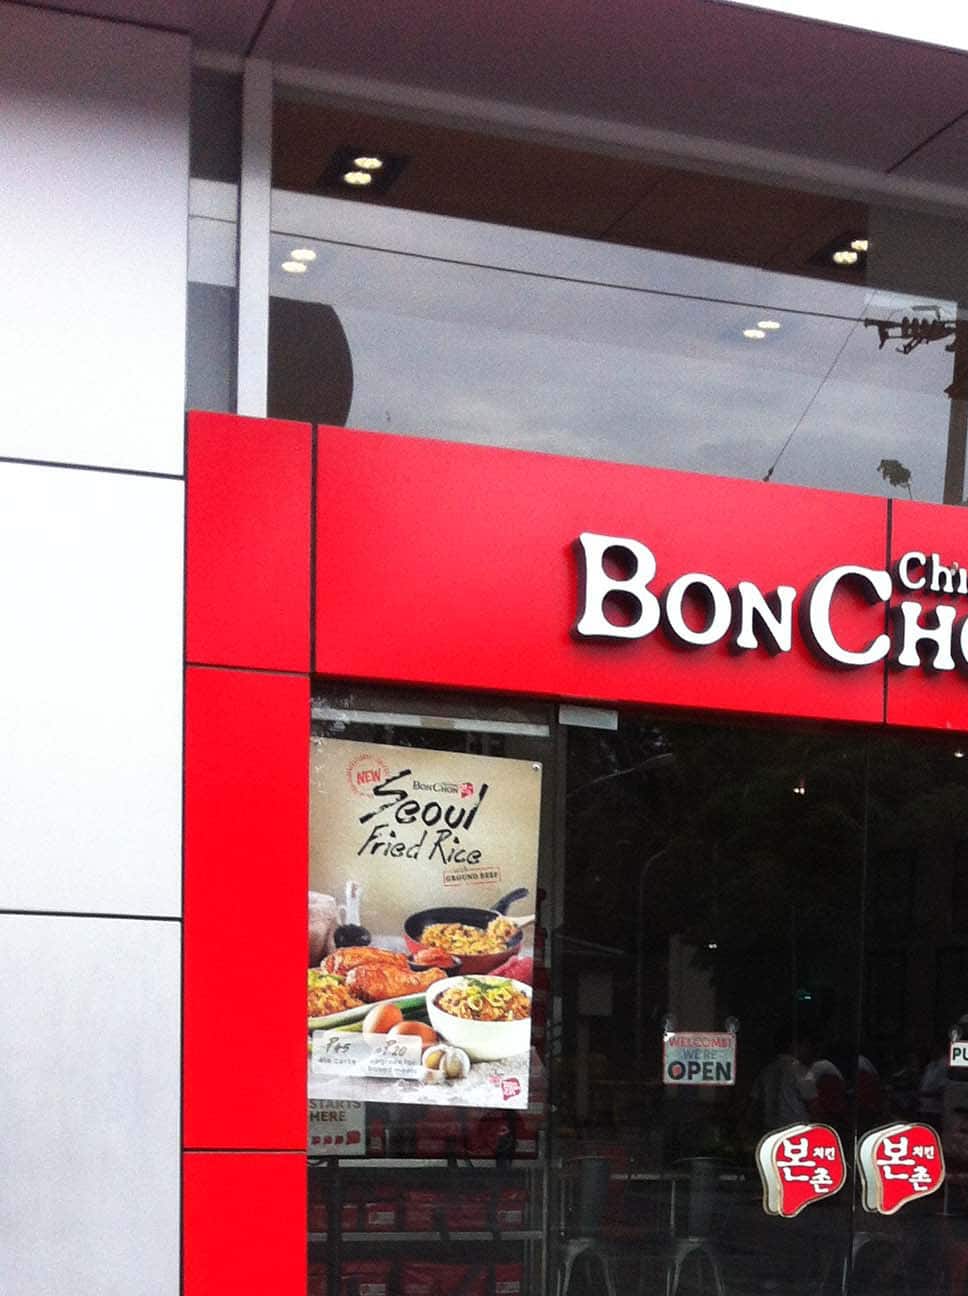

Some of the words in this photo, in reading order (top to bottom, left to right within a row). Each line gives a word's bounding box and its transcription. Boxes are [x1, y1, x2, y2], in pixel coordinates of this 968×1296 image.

[357, 768, 381, 785] NEW
[359, 769, 488, 830] Seoul
[357, 824, 428, 859] Fried
[429, 829, 481, 864] Rice
[668, 1060, 731, 1081] OPEN
[309, 1110, 346, 1121] HERE
